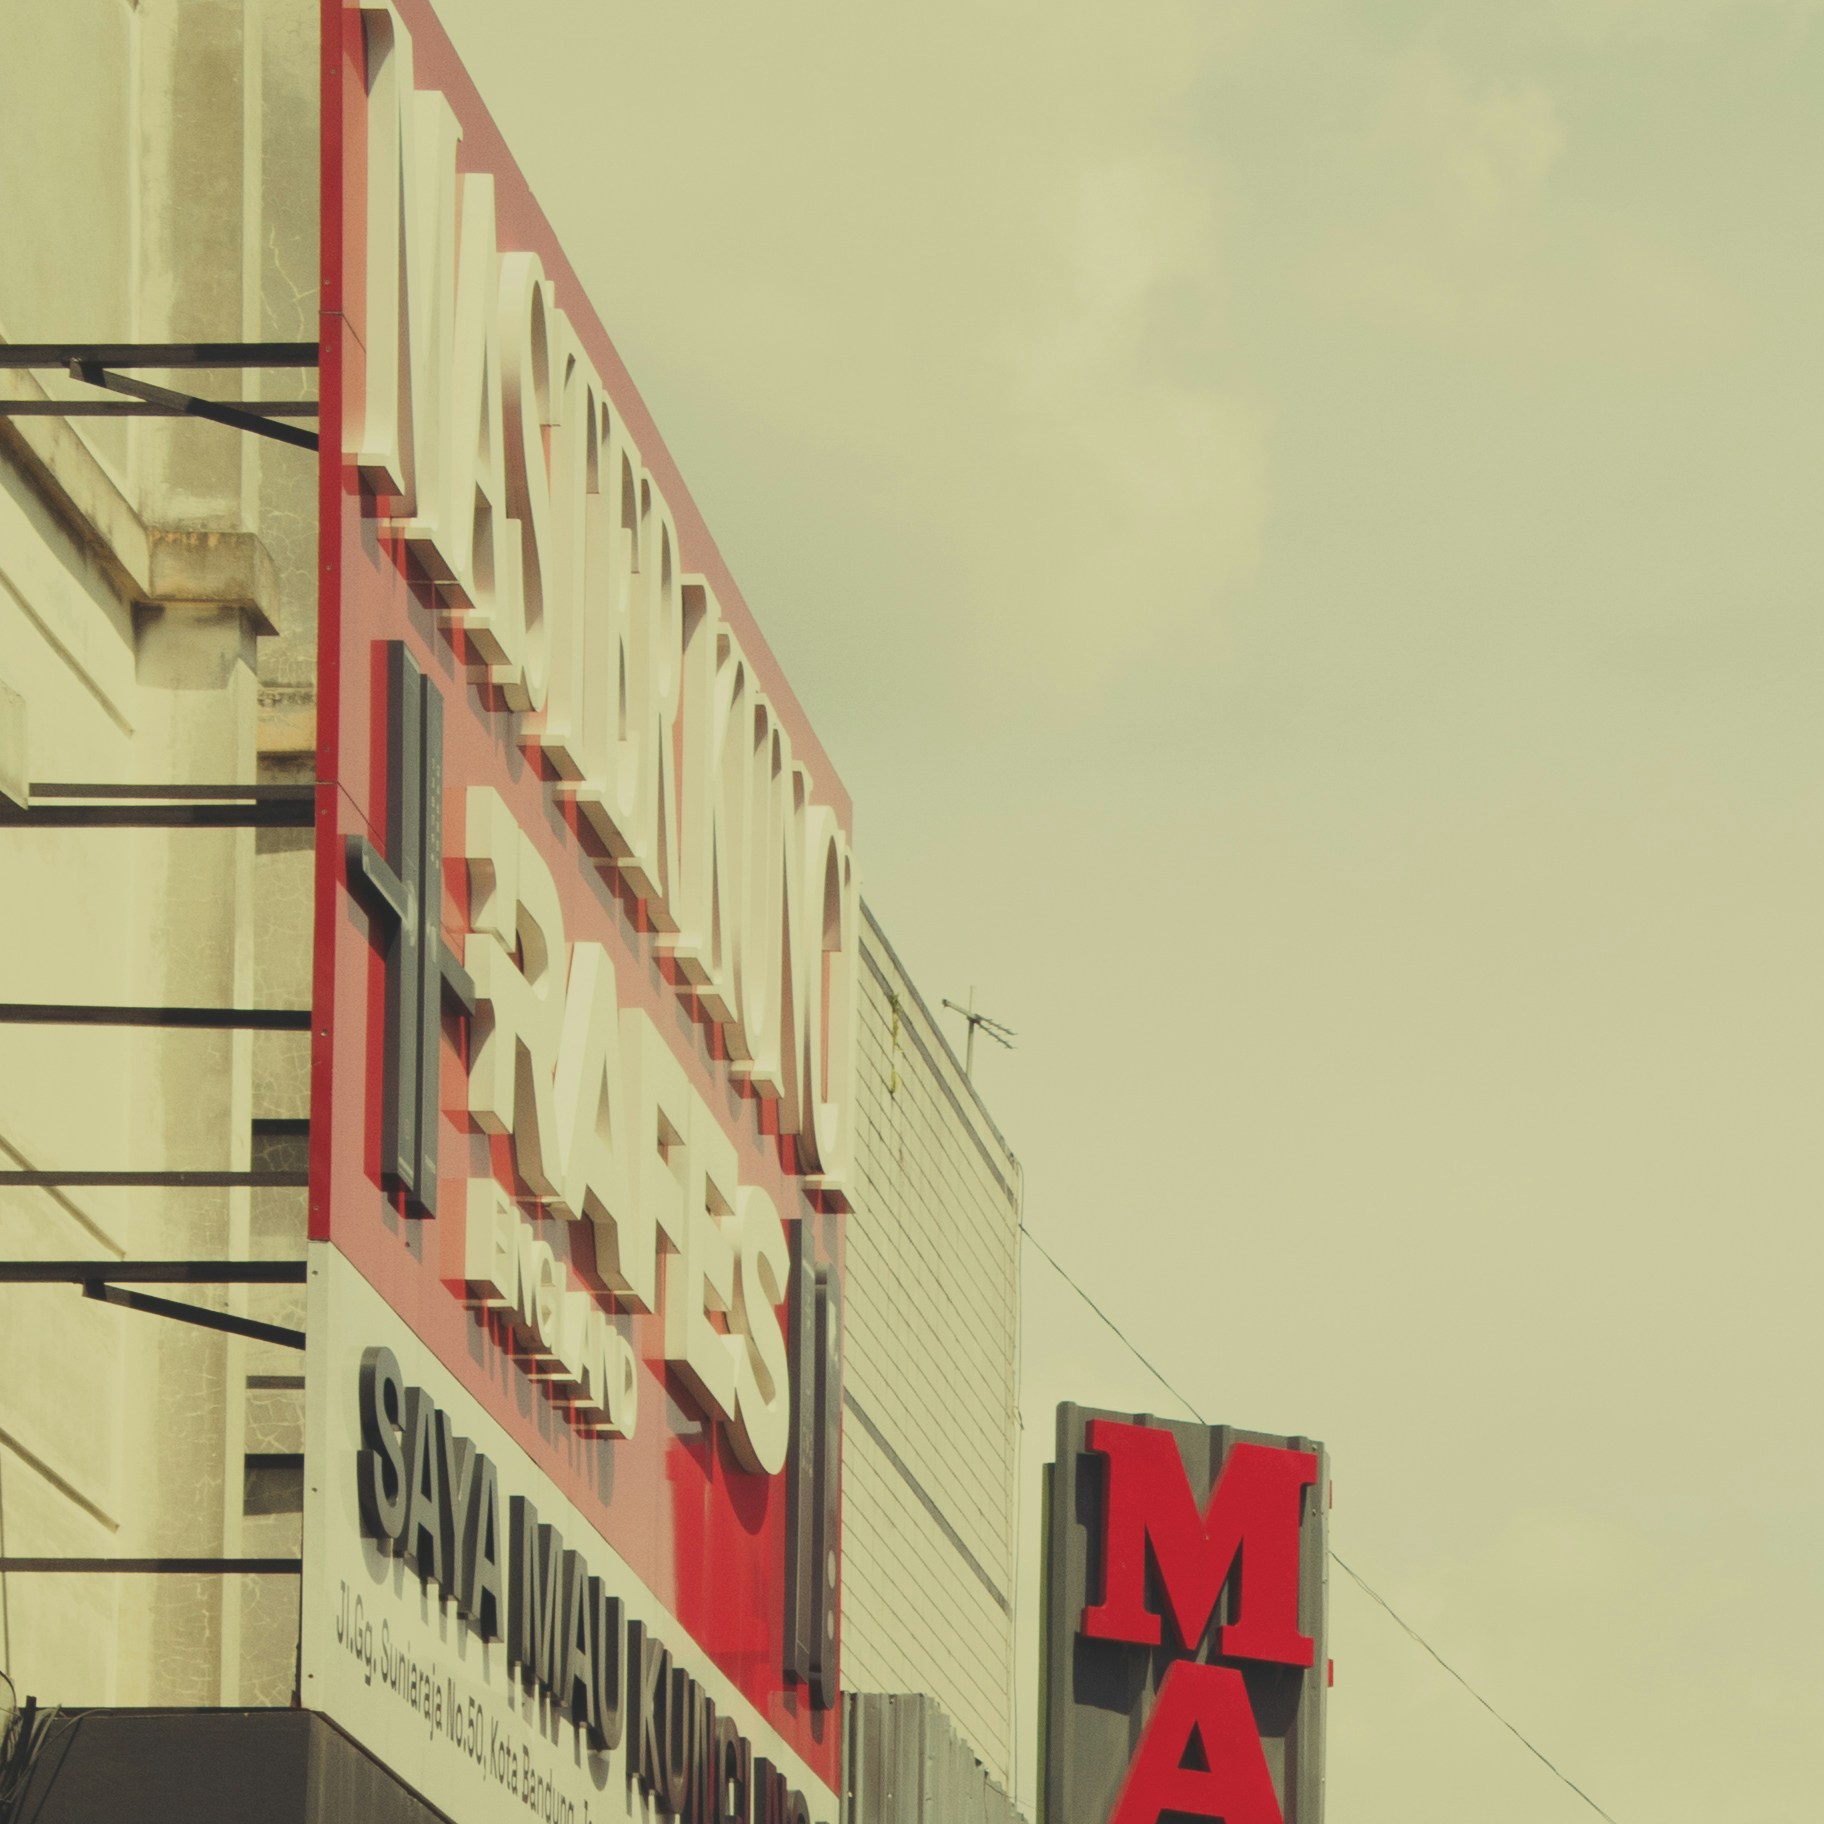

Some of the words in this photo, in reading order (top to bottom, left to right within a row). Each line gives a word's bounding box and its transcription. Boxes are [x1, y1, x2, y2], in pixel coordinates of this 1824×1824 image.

[466, 785, 790, 1475] RAFES
[464, 1178, 638, 1440] ENGLAND
[358, 1347, 503, 1643] SAYA
[508, 1495, 624, 1751] MAU
[381, 1618, 442, 1739] Suniaraja
[447, 1678, 486, 1779] No.50,
[490, 1716, 518, 1796] Kota
